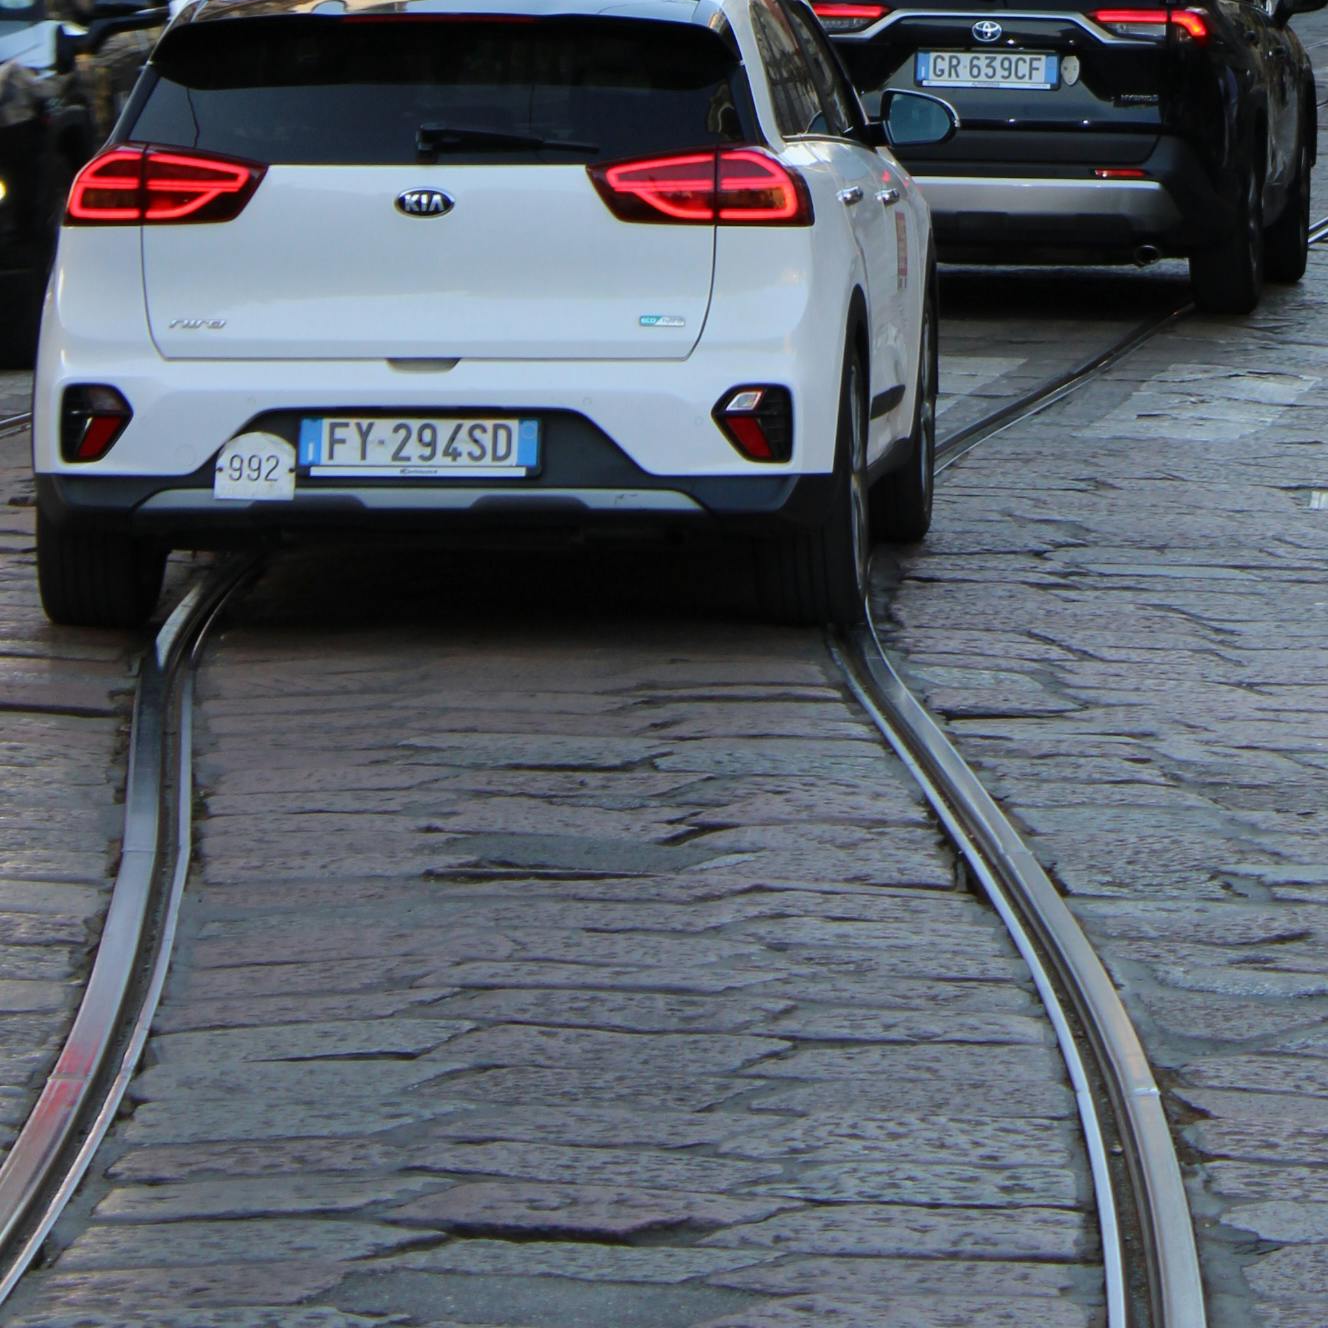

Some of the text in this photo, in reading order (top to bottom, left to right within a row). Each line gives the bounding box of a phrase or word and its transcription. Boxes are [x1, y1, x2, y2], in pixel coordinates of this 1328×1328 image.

[968, 55, 1043, 81] 639CF
[404, 193, 445, 212] KIA
[390, 422, 514, 463] 294SD
[228, 453, 281, 482] 992
